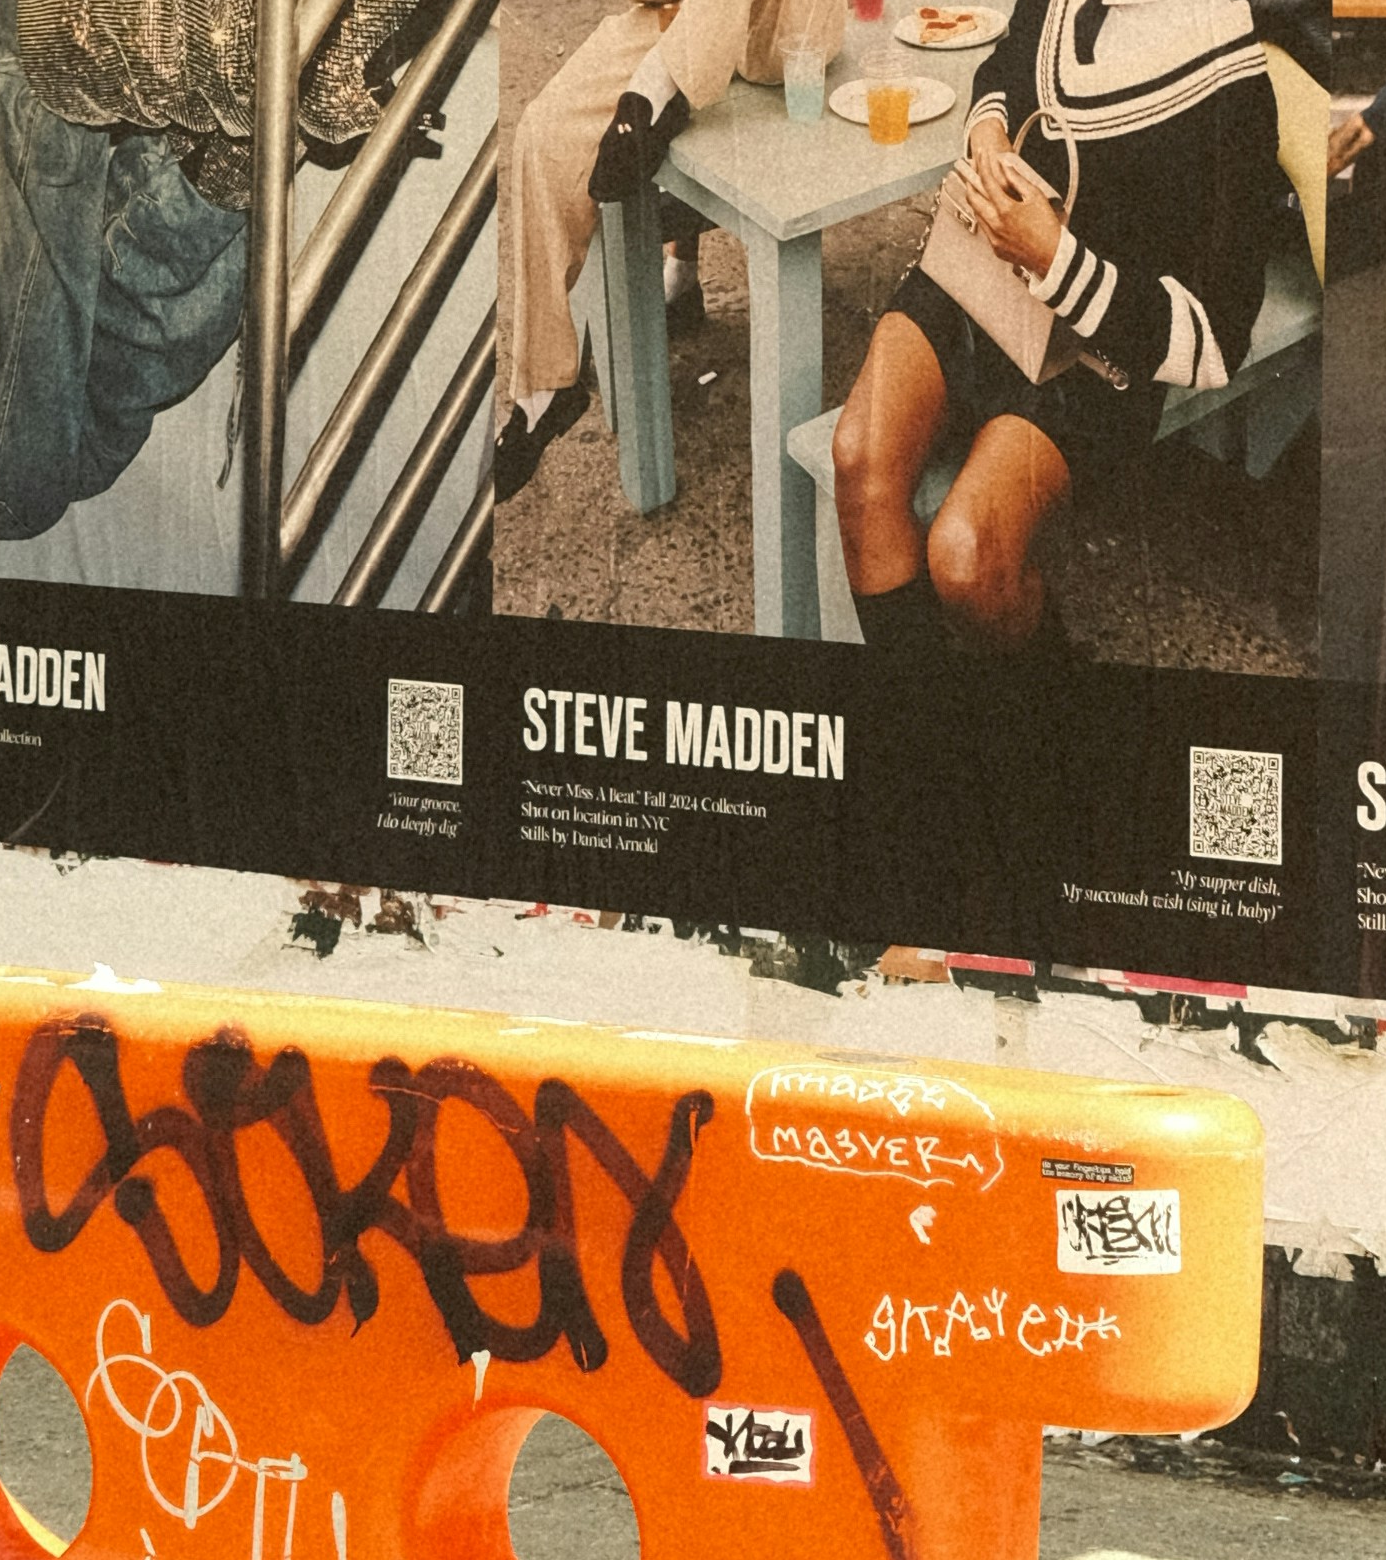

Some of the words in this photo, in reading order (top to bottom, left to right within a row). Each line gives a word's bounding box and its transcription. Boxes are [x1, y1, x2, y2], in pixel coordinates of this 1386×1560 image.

[523, 687, 648, 761] STEVE
[666, 700, 844, 781] MADDEN
[565, 783, 593, 800] Miss
[596, 787, 606, 802] A
[644, 791, 666, 808] Fall
[669, 793, 698, 811] 2024
[701, 797, 767, 819] Collection
[383, 812, 399, 828] do
[401, 815, 437, 837] deeply
[521, 802, 549, 819] Shot
[551, 807, 570, 822] on
[573, 805, 622, 827] location
[626, 813, 638, 828] in
[641, 814, 670, 832] NYC
[521, 825, 550, 842] Stills
[552, 828, 568, 849] by
[573, 831, 612, 849] Daniel
[615, 835, 658, 854] Arnold
[1061, 883, 1083, 904] My
[1084, 889, 1148, 907] succotash
[1152, 893, 1183, 911] wish
[1199, 875, 1246, 895] supper
